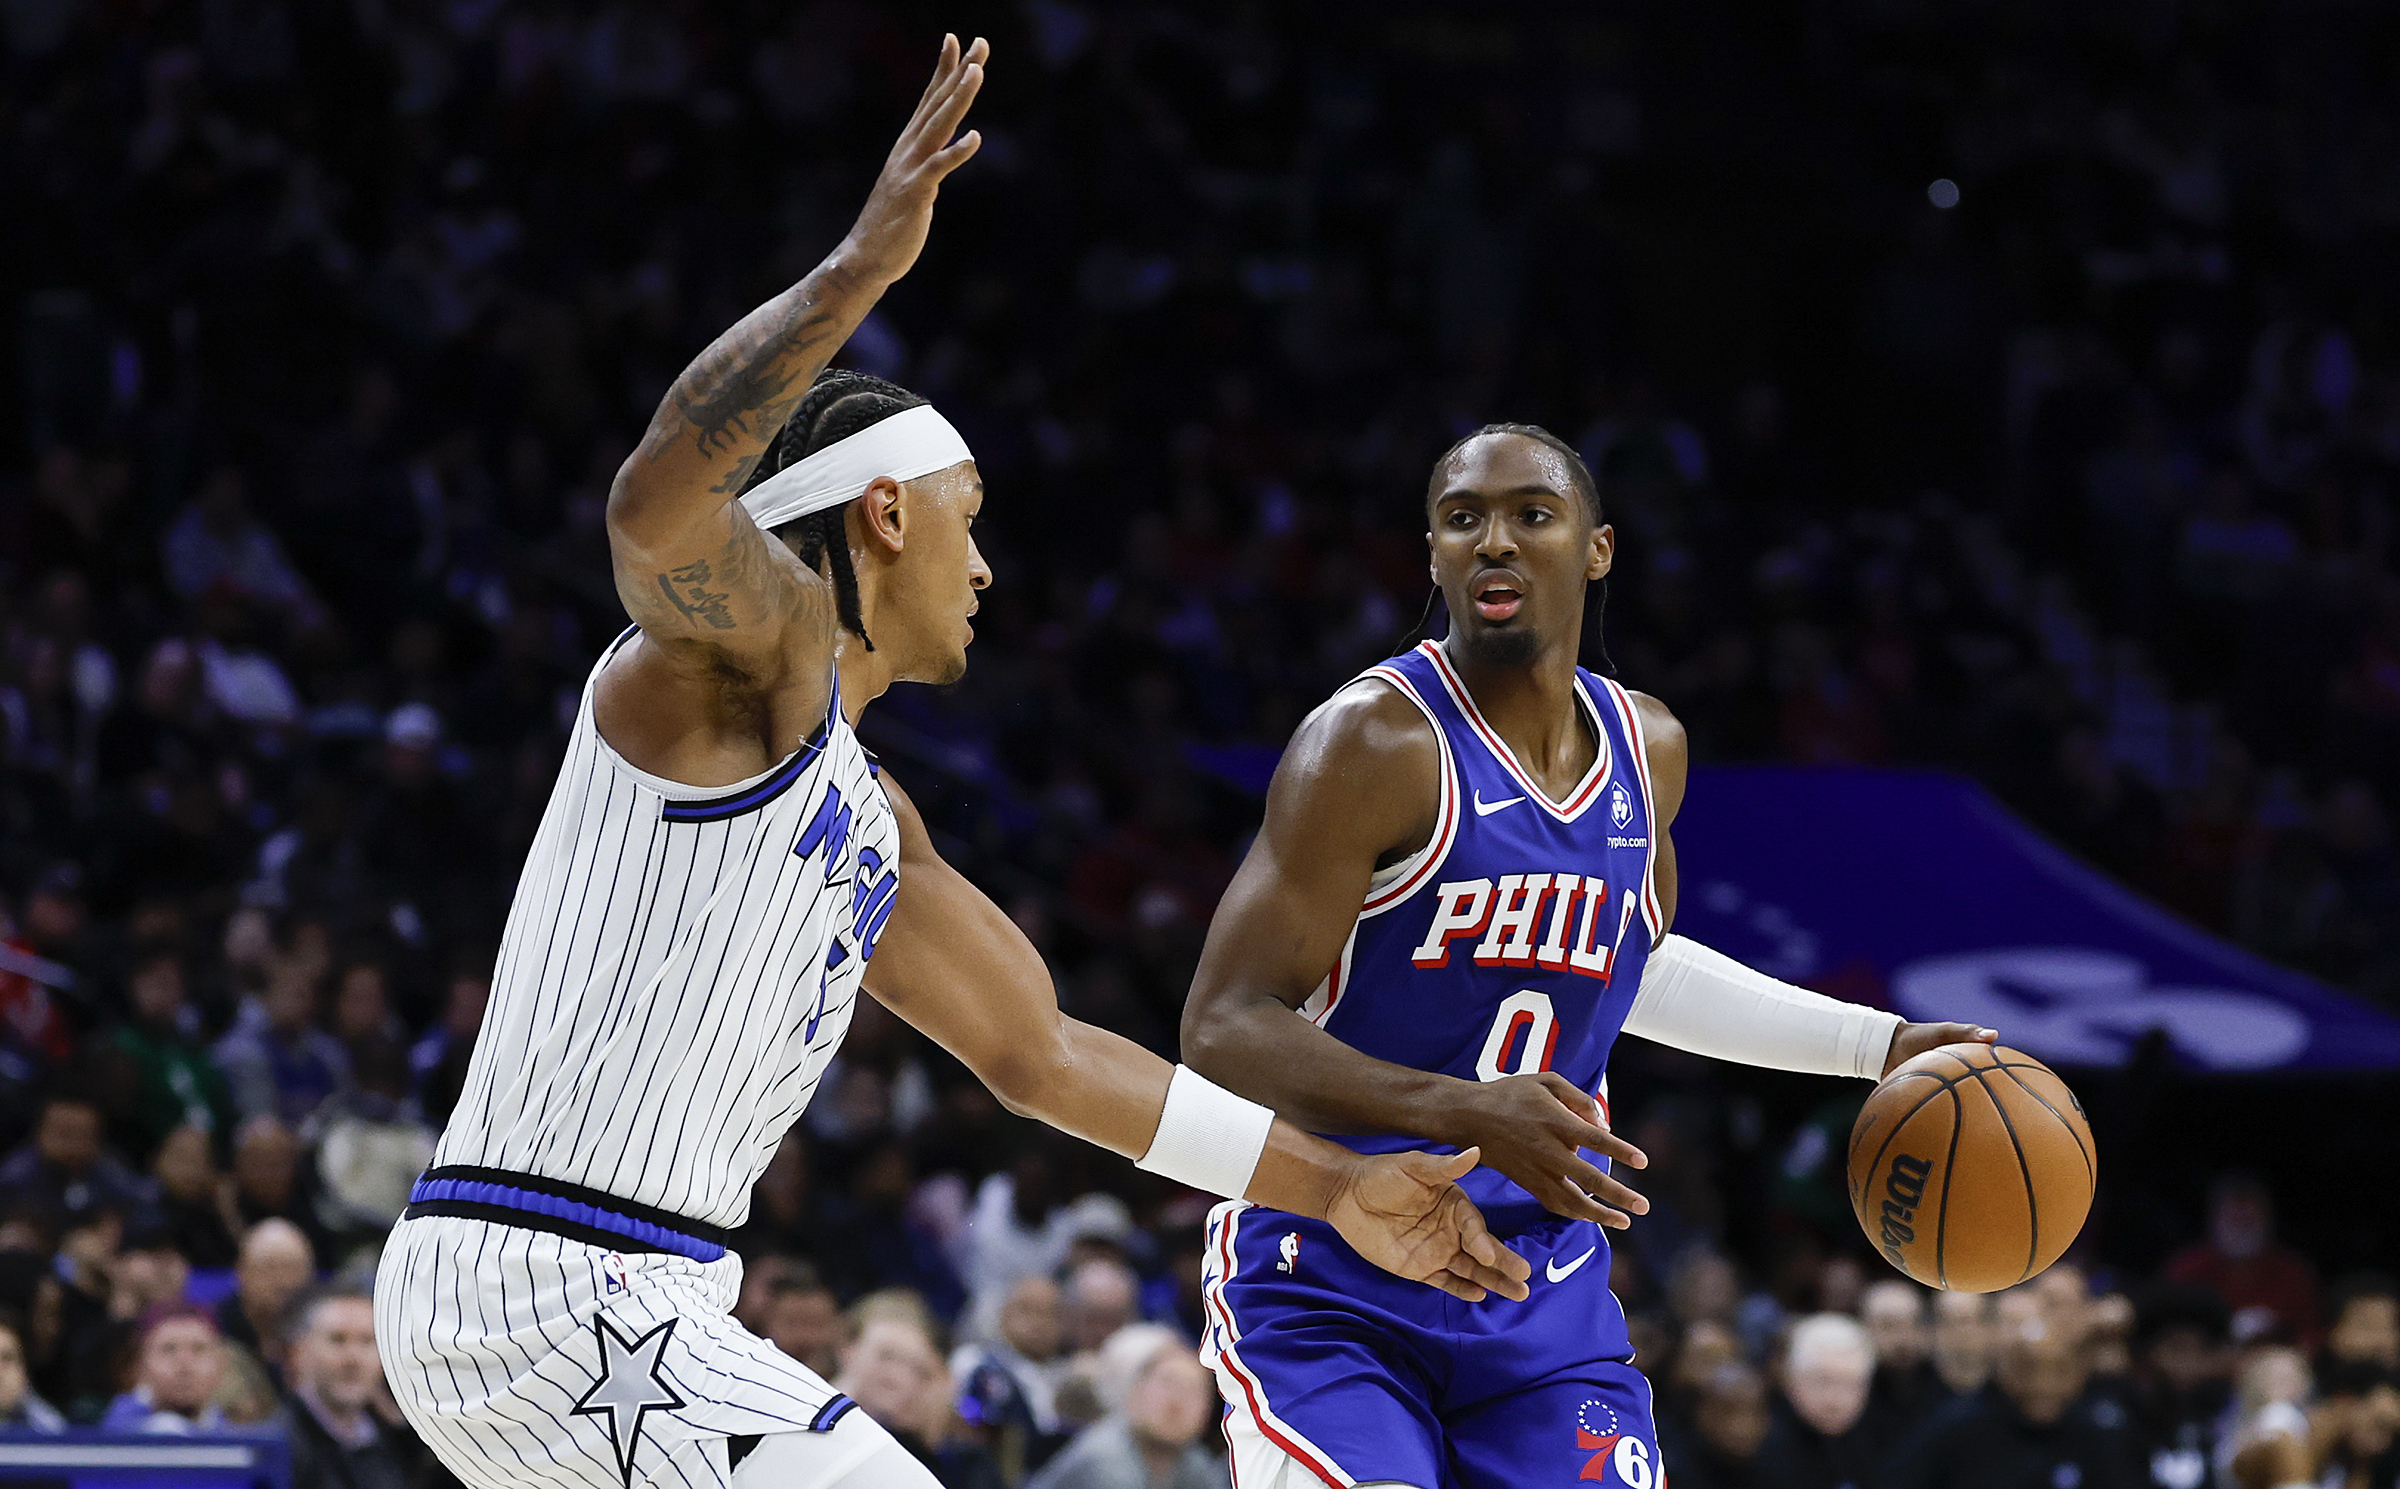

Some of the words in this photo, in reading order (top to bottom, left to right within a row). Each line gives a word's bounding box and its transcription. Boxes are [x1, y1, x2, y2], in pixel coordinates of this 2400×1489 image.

[1607, 836, 1647, 849] rypto.com
[1475, 989, 1560, 1083] 0
[1576, 1427, 1653, 1489] 76
